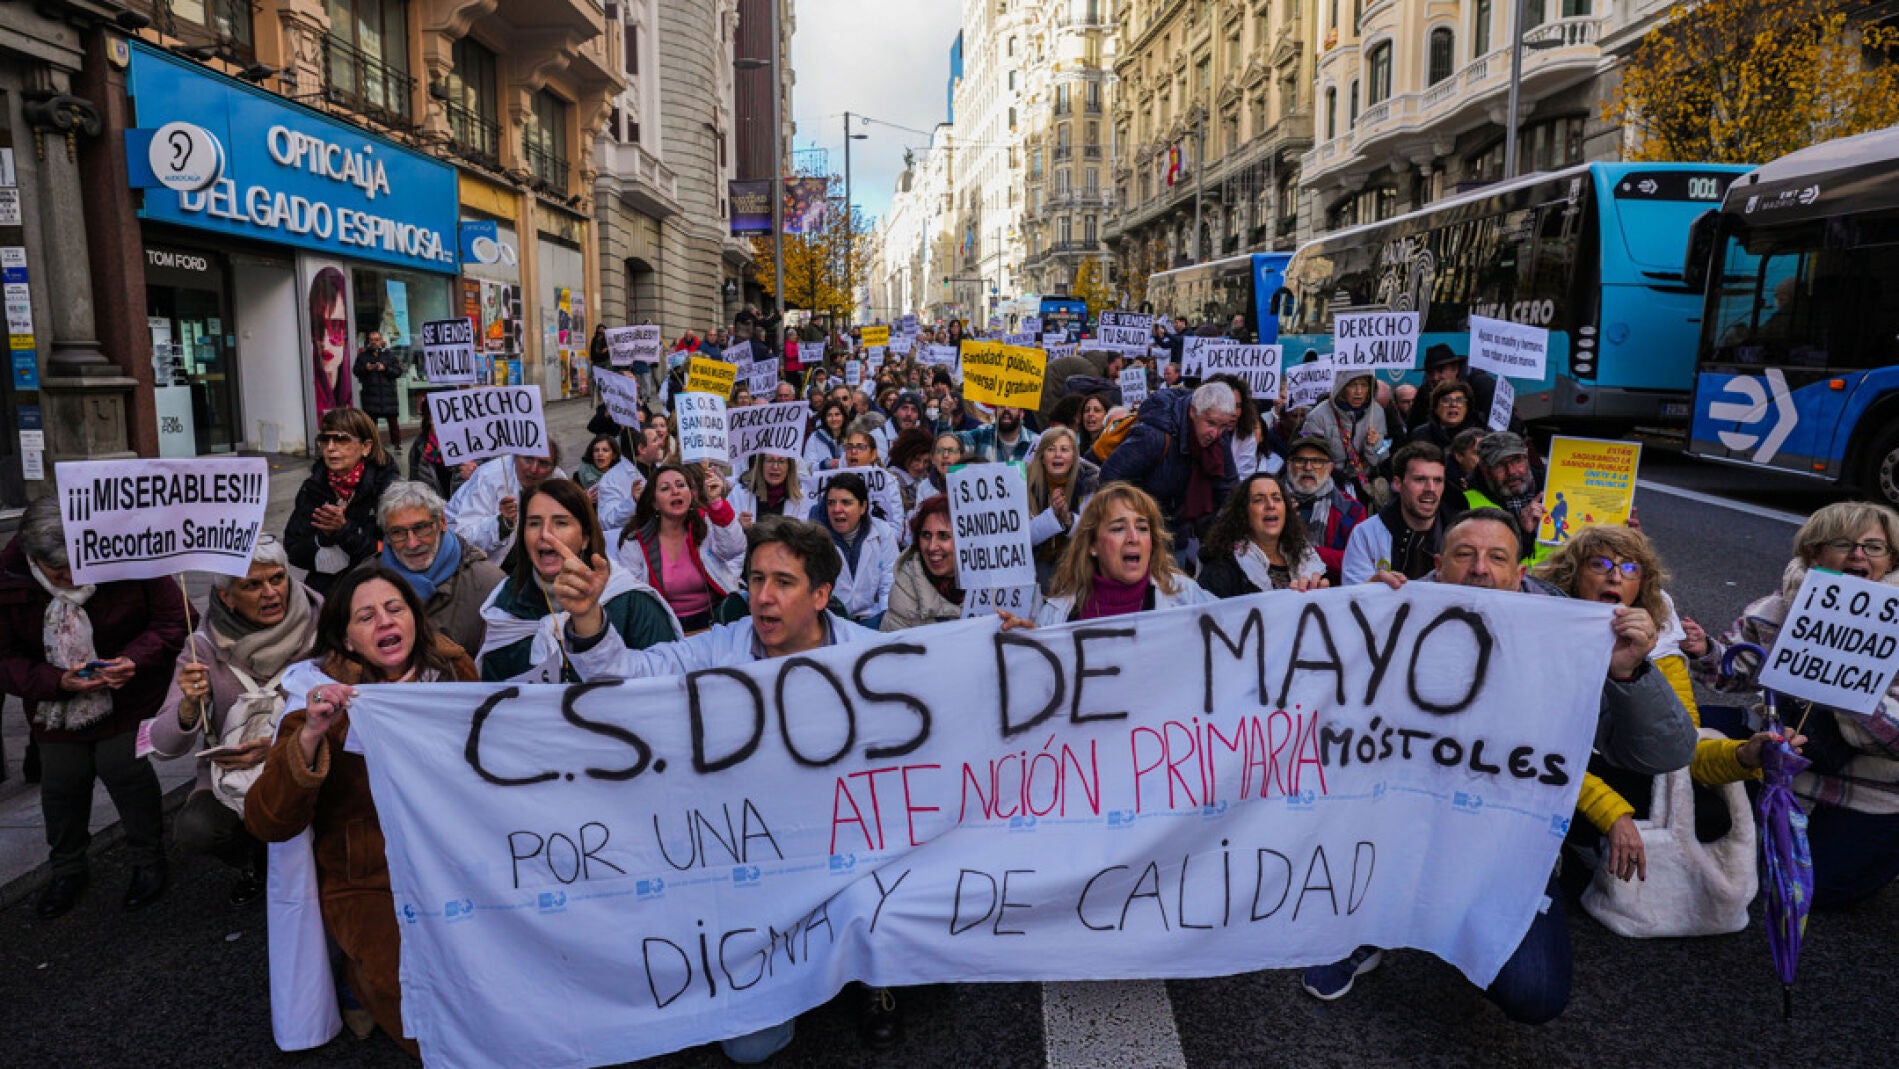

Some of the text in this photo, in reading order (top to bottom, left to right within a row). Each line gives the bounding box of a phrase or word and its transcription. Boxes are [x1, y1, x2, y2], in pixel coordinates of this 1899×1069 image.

[1688, 177, 1719, 198] 001
[179, 177, 444, 261] DELGADO ESPINOSA
[146, 250, 207, 271] TOM FORD
[1103, 312, 1152, 329] SE VENDE
[1511, 299, 1554, 324] CERO
[424, 322, 470, 344] SE VENDE
[1103, 328, 1115, 343] TU
[1340, 316, 1412, 338] DERECHO
[1207, 348, 1276, 368] DERECHO
[1338, 340, 1412, 364] a la SALUD.
[997, 380, 1004, 396] y
[435, 390, 532, 424] DERECHO
[730, 406, 801, 431] DERECHO
[161, 416, 178, 426] TOM
[161, 423, 184, 434] FORD
[682, 416, 723, 431] SANIDAD
[445, 419, 542, 457] a la SALUD.
[729, 426, 799, 458] a la SALUD.
[69, 473, 263, 521] ¡¡¡MISERABLES!!!
[957, 509, 1020, 538] SANIDAD
[75, 526, 176, 570] ¡Recortan
[960, 543, 1026, 571] PÚBLICA!
[1792, 615, 1897, 660] SANIDAD
[993, 627, 1137, 738] DE
[1200, 601, 1494, 715] MAYO
[1773, 648, 1884, 695] PÚBLICA!
[507, 820, 627, 889] POR
[653, 798, 784, 871] UNA
[1320, 716, 1570, 787] MÓSTOLES
[870, 869, 912, 933] Y
[949, 868, 1036, 936] DE
